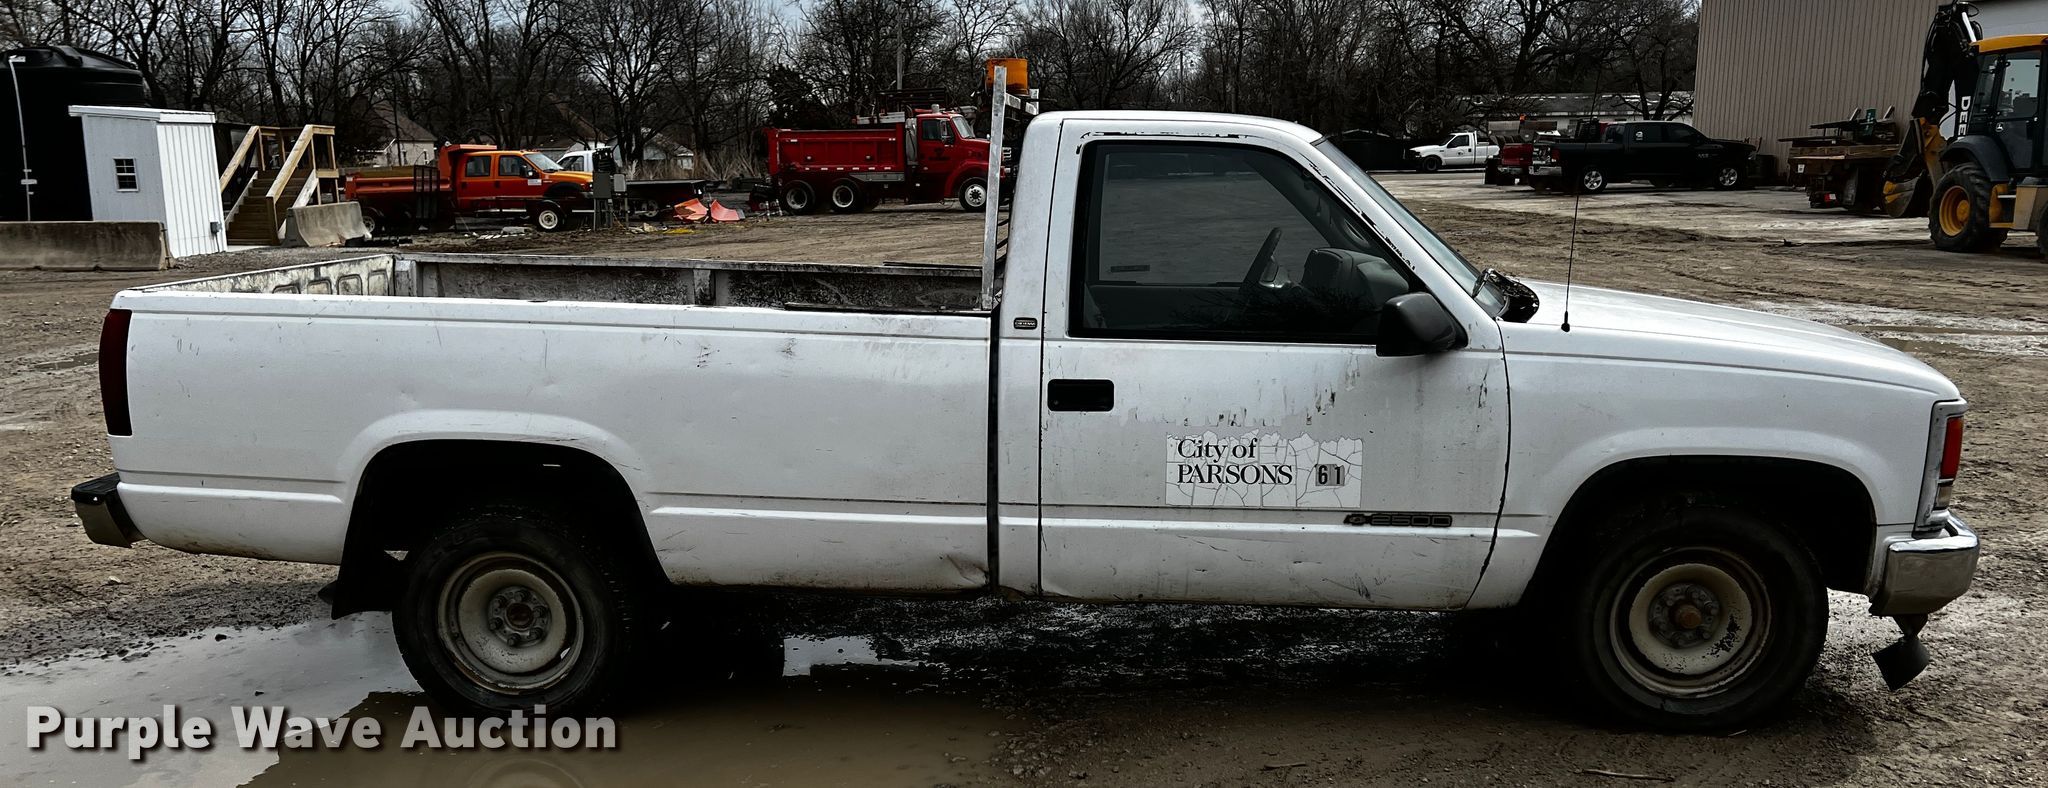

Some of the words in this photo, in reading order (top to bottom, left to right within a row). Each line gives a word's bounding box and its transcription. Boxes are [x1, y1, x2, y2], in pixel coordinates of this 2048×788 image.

[1177, 438, 1228, 463] City
[1232, 437, 1258, 459] of
[1177, 463, 1293, 485] PARSONS
[1317, 465, 1342, 485] 61
[1370, 513, 1452, 527] 2500
